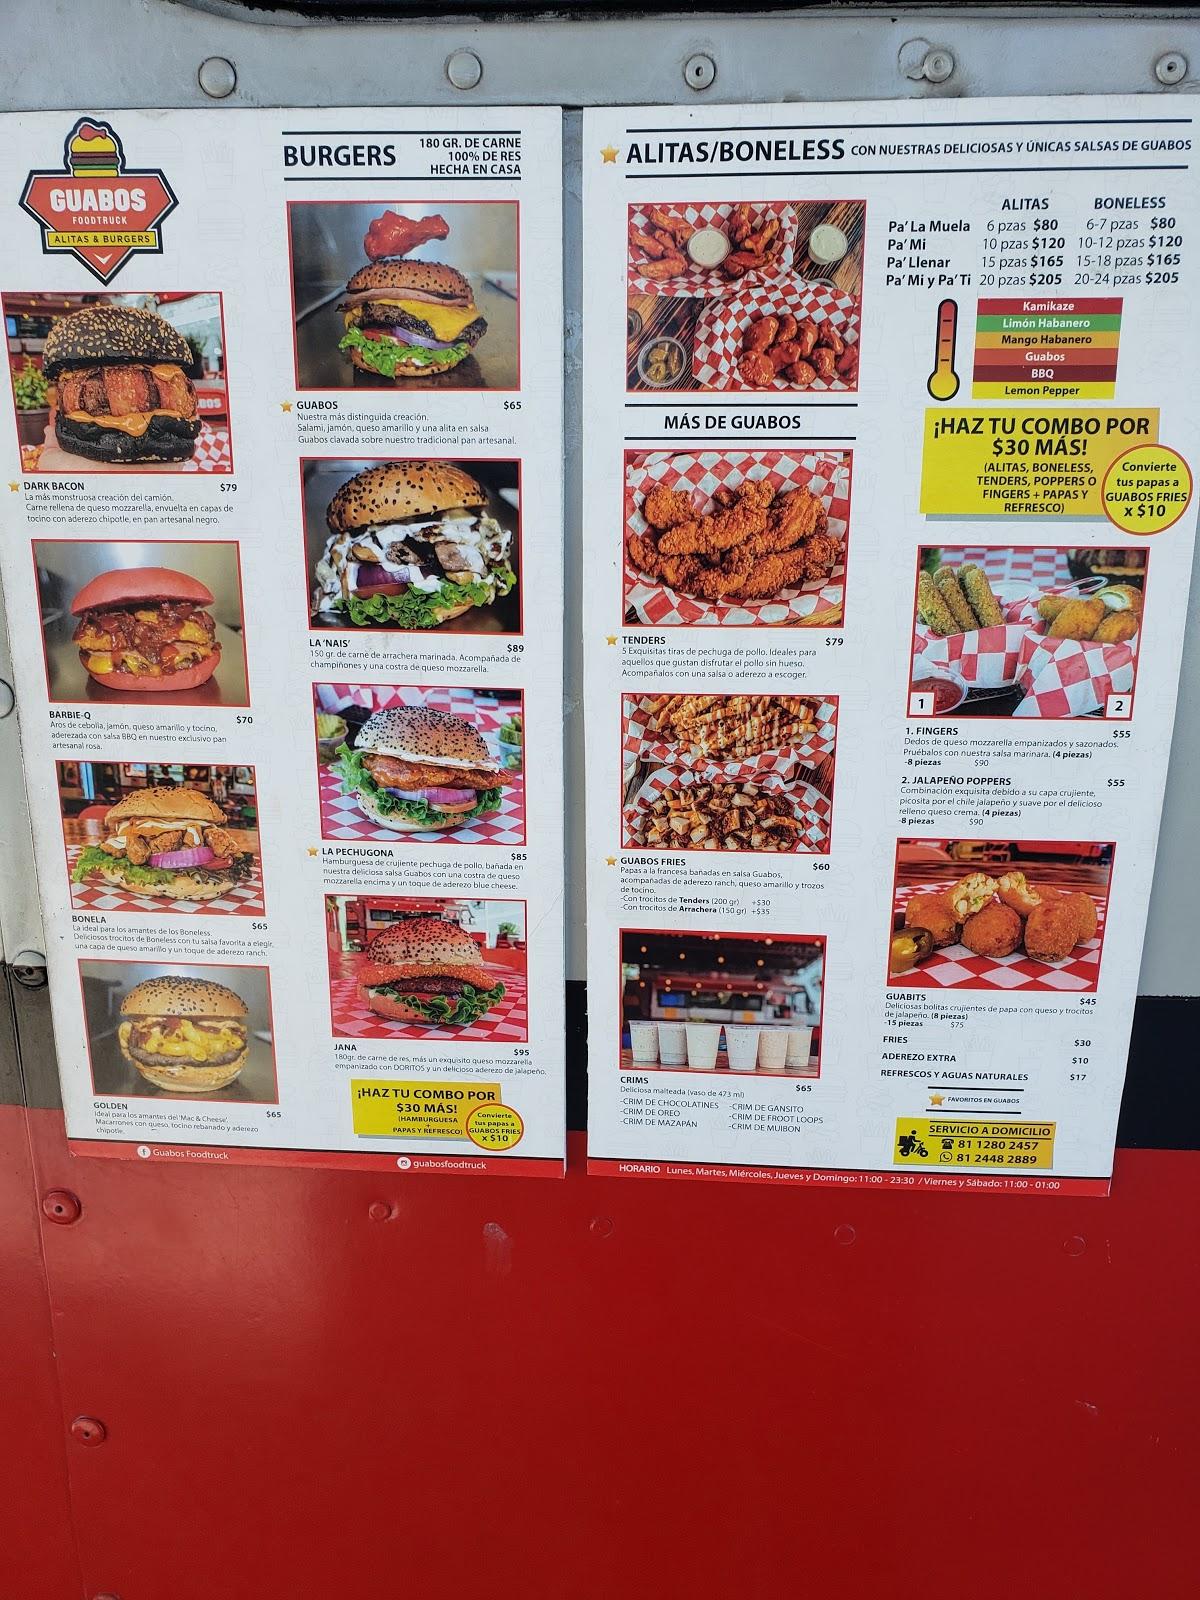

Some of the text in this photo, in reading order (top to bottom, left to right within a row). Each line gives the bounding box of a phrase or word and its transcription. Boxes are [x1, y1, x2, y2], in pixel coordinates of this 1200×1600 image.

[420, 138, 521, 148] 180 GR. DE CARNE
[626, 139, 845, 163] ALITAS/BONELESS
[851, 140, 1191, 156] CON NUESTRAS DELICIOSAS Y ÚNICAS SALSAS DE GUABOS
[284, 145, 396, 166] BURGERS
[448, 151, 521, 161] 100% DE RES
[430, 164, 521, 174] HECHA EN CASA
[50, 188, 146, 212] GUABOS
[1002, 198, 1049, 211] ALITAS
[1094, 197, 1166, 209] BONELESS
[72, 216, 127, 225] FOODTRUCK
[1086, 216, 1176, 233] 6-7 pzas $80
[911, 221, 925, 232] La
[929, 220, 970, 232] Muela
[987, 218, 1058, 234] 6 pzas $80
[55, 235, 150, 243] ALITAS & BURGERS
[908, 274, 924, 286] Mi
[927, 277, 935, 289] y
[960, 274, 971, 285] Ti
[979, 273, 1062, 288] 20 pzas $205
[1074, 271, 1179, 287] 20-24 pzas $205
[1023, 301, 1074, 311] Kamikaze
[1003, 318, 1090, 328] Limón Habanero
[1001, 334, 1092, 347] Mango Habanero
[1025, 351, 1065, 361] Guabos
[1031, 368, 1054, 379] BBQ
[1005, 386, 1080, 397] Lemon Pepper
[296, 401, 338, 410] GUABOS
[504, 400, 522, 411] $65
[664, 413, 801, 429] MÁS DE GUABOS
[297, 423, 326, 432] Salami,
[326, 423, 354, 434] jamón,
[355, 425, 380, 433] queso
[381, 424, 414, 432] amarillo
[415, 425, 420, 434] y
[439, 424, 456, 432] alita
[470, 424, 489, 432] salsa
[934, 418, 1150, 438] ¡HAZ TU COMBO POR
[992, 436, 1087, 457] $30 MÁS!
[24, 482, 84, 491] DARK BACON
[220, 483, 237, 492] $79
[24, 493, 34, 501] La
[35, 493, 51, 501] más
[130, 493, 143, 501] del
[309, 639, 321, 647] LA
[622, 636, 666, 645] TENDERS
[825, 637, 844, 646] $79
[507, 644, 524, 653] $89
[621, 658, 654, 667] aquellos
[672, 660, 699, 668] gustan
[700, 658, 733, 667] disfrutar
[744, 659, 764, 669] pollo
[49, 711, 91, 720] BARBIE-Q
[236, 715, 253, 724] $70
[916, 727, 958, 735] FINGERS
[1113, 730, 1131, 739] $55
[901, 775, 1011, 785] 2. JALAPEÑO POPPERS
[1107, 778, 1125, 787] $55
[336, 848, 394, 857] PECHUGONA
[511, 852, 527, 861] $85
[620, 857, 686, 866] GUABOS FRIES
[813, 862, 830, 871] $60
[72, 915, 106, 923] BONELA
[252, 922, 268, 930] $65
[886, 993, 926, 1001] GUABITS
[1080, 997, 1097, 1006] $45
[883, 1036, 908, 1044] FRIES
[1074, 1039, 1091, 1047] $30
[514, 1048, 530, 1056] $95
[882, 1053, 956, 1062] ADEREZO EXTRA
[881, 1069, 932, 1078] REFRESCOS
[975, 1073, 1028, 1081] NATURALES
[1070, 1073, 1087, 1081] $17
[620, 1076, 649, 1084] CRIMS
[796, 1084, 812, 1092] $65
[93, 1102, 128, 1110] GOLDEN
[266, 1110, 282, 1118] $65
[657, 1109, 680, 1117] OREO
[929, 1125, 979, 1134] SERVICIO
[992, 1127, 1051, 1136] DOMICILIO
[958, 1140, 1039, 1150] 81 1280 2457
[153, 1149, 229, 1159] Guabos Foodtruck
[957, 1154, 1037, 1164] 81 2448 2889
[411, 1160, 486, 1169] guabosfoodtruck
